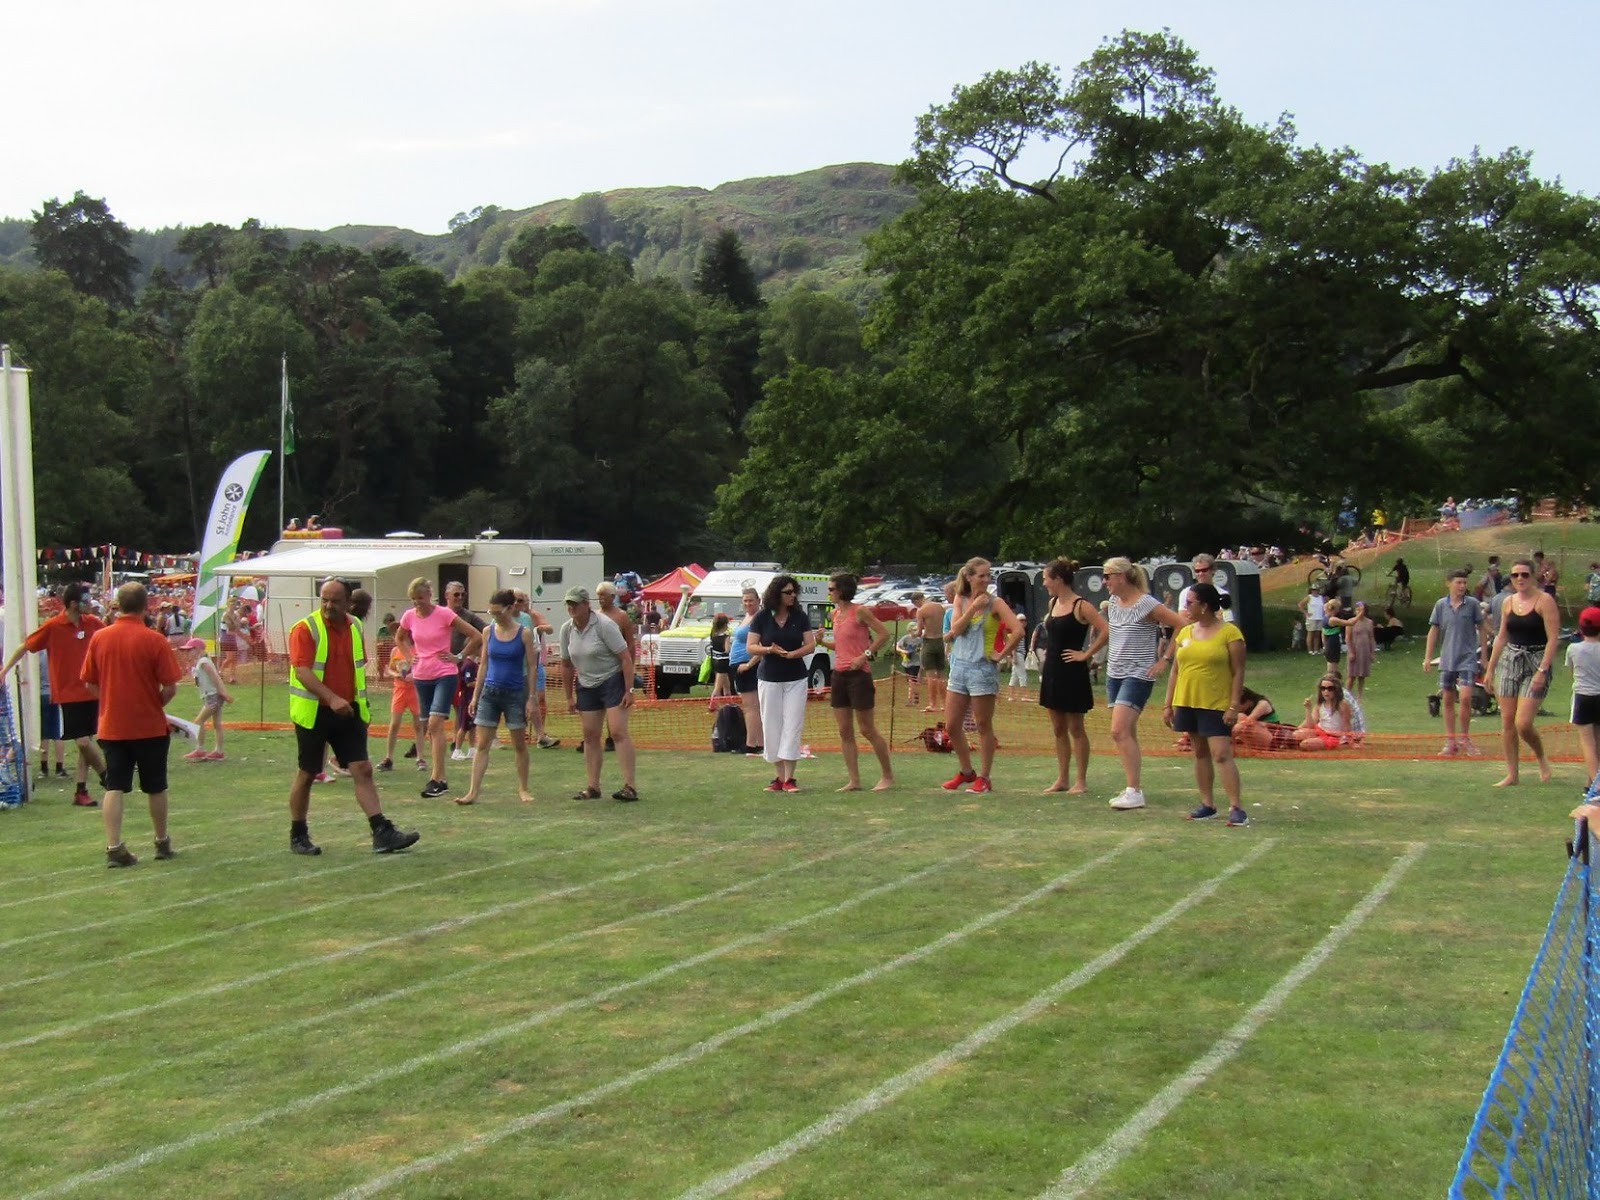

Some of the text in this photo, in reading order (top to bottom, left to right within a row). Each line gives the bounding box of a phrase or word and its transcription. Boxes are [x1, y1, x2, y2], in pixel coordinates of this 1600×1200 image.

[216, 503, 231, 535] St John
[801, 586, 818, 595] LANCE
